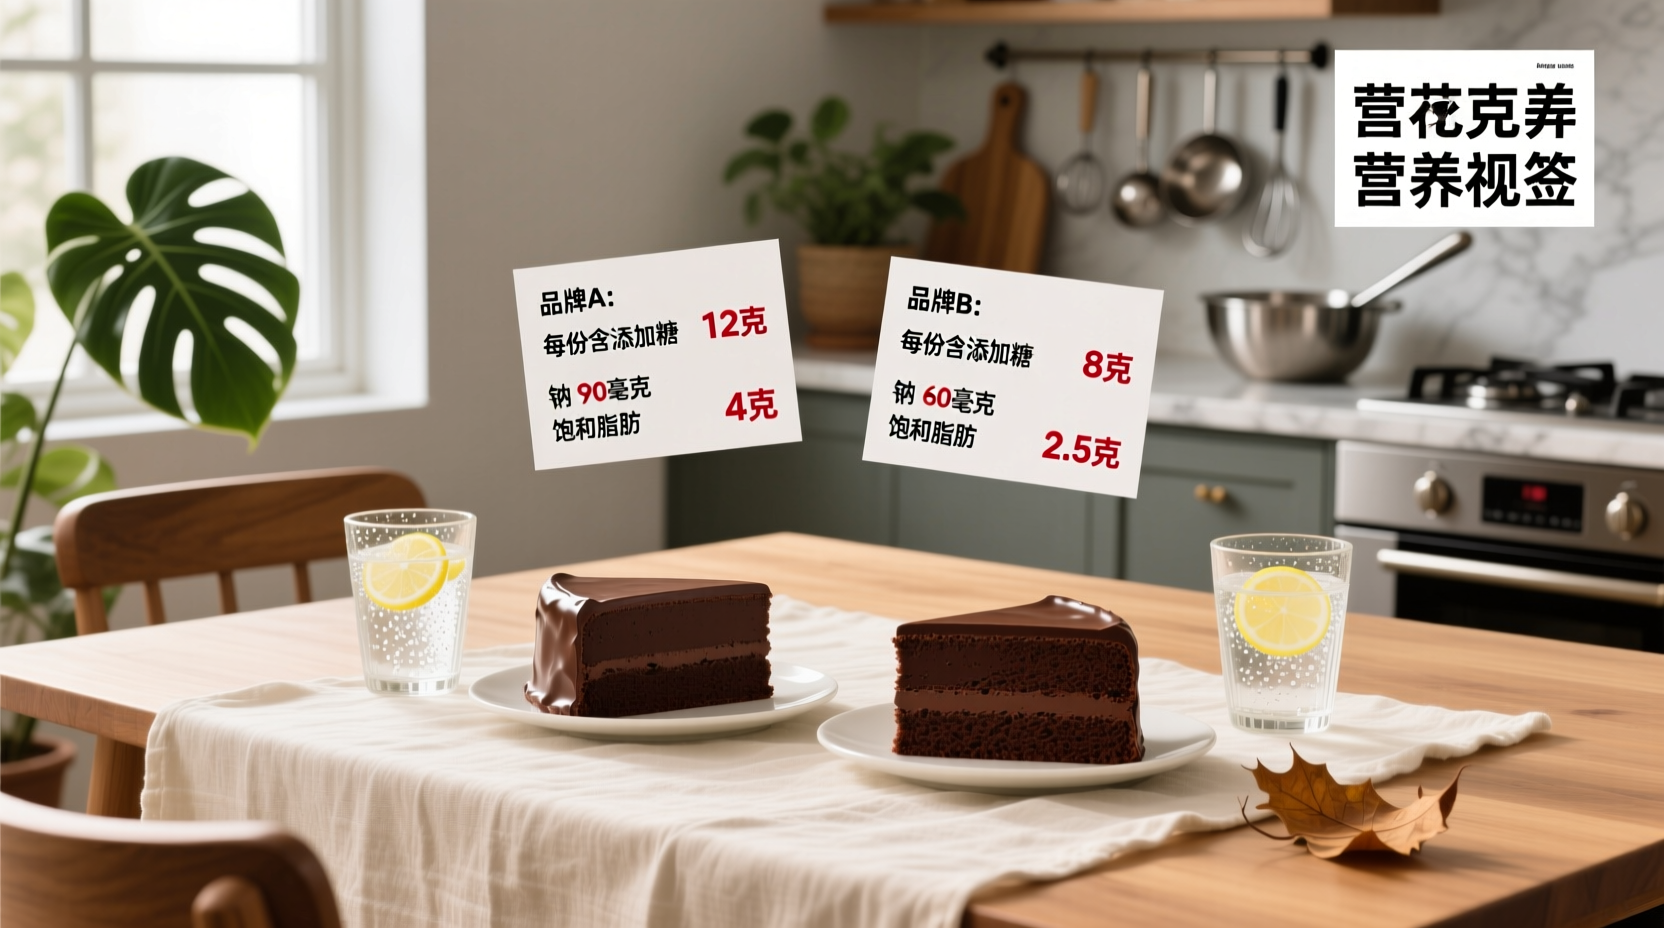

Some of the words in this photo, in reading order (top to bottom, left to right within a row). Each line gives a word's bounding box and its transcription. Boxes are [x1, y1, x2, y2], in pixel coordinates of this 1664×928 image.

[543, 320, 679, 357] 每份含添加糖
[702, 306, 767, 338] 12克
[901, 329, 1034, 368] 每份含添加糖
[1083, 350, 1133, 384] 8克
[549, 384, 571, 409] 钠
[577, 375, 651, 404] 90毫克
[553, 411, 640, 442] 饱和脂肪
[726, 388, 778, 422] 4克
[893, 380, 915, 405] 钠
[923, 386, 996, 416] 60毫克
[889, 414, 978, 448] 饱和脂肪
[1042, 431, 1121, 469] 2.5克
